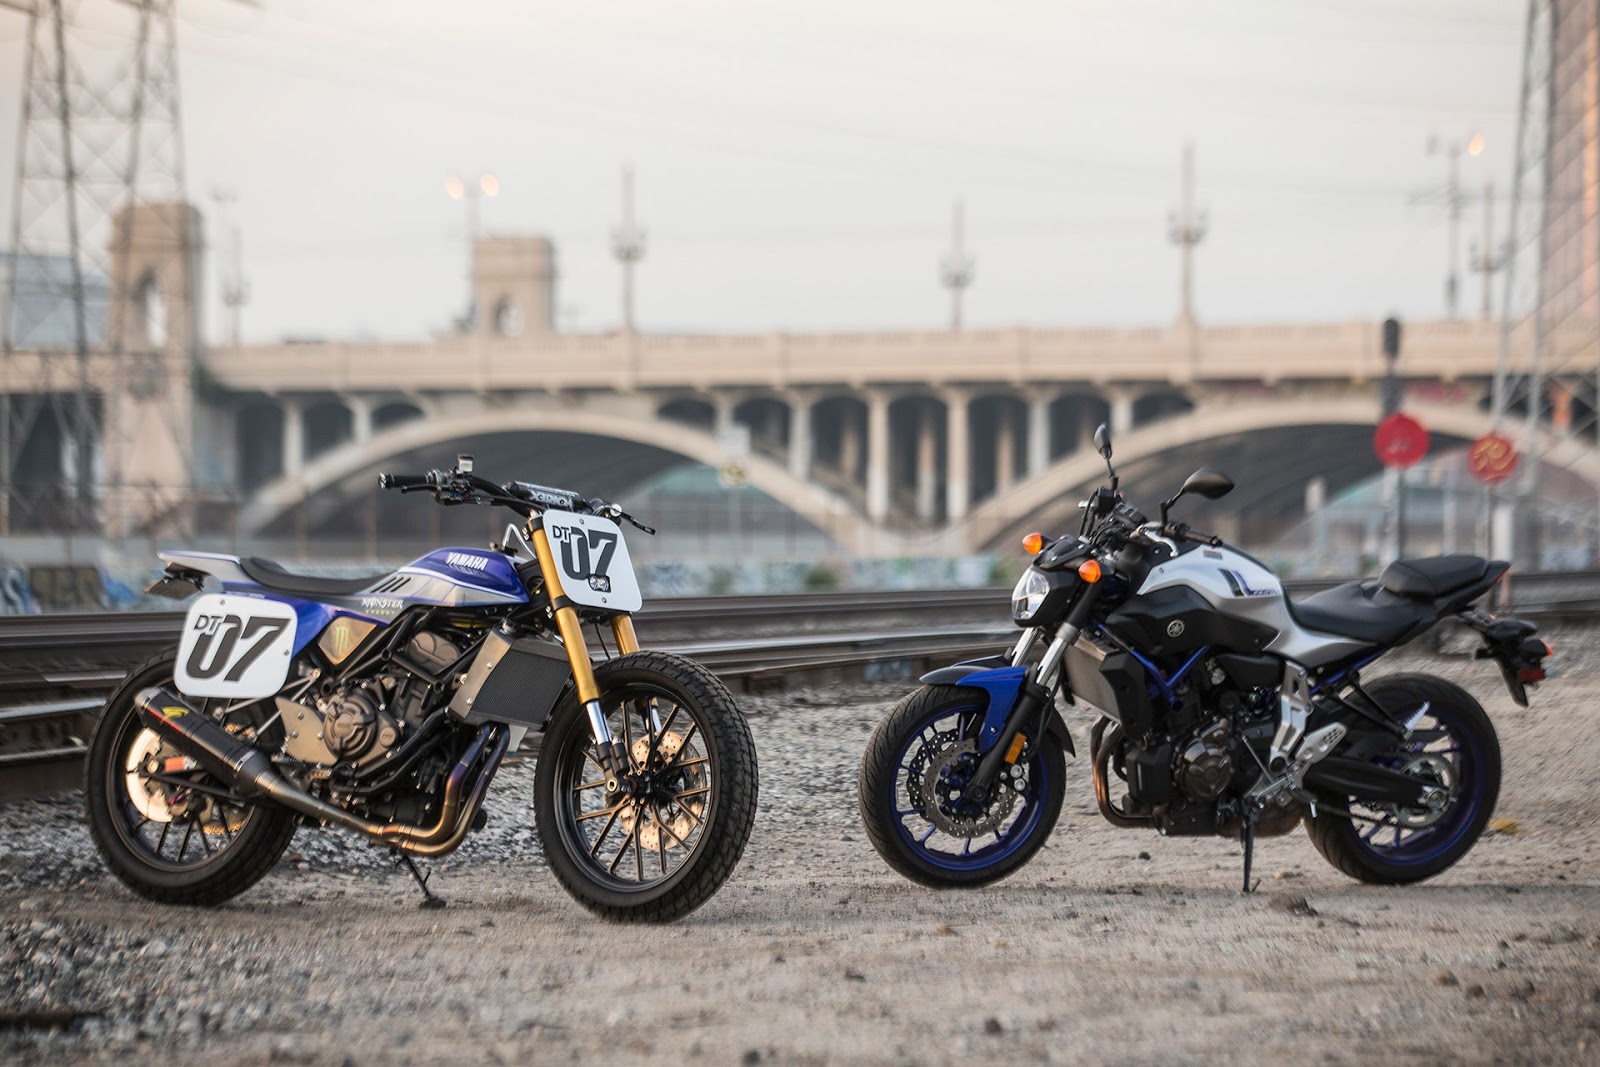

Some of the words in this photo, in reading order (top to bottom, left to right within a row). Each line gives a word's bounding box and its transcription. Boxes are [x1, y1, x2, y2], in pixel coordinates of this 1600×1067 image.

[552, 525, 570, 543] DT
[446, 552, 489, 571] YAMAHA
[560, 526, 618, 581] 07
[361, 597, 405, 609] MONSTER
[194, 614, 223, 635] DT
[186, 614, 292, 682] 07
